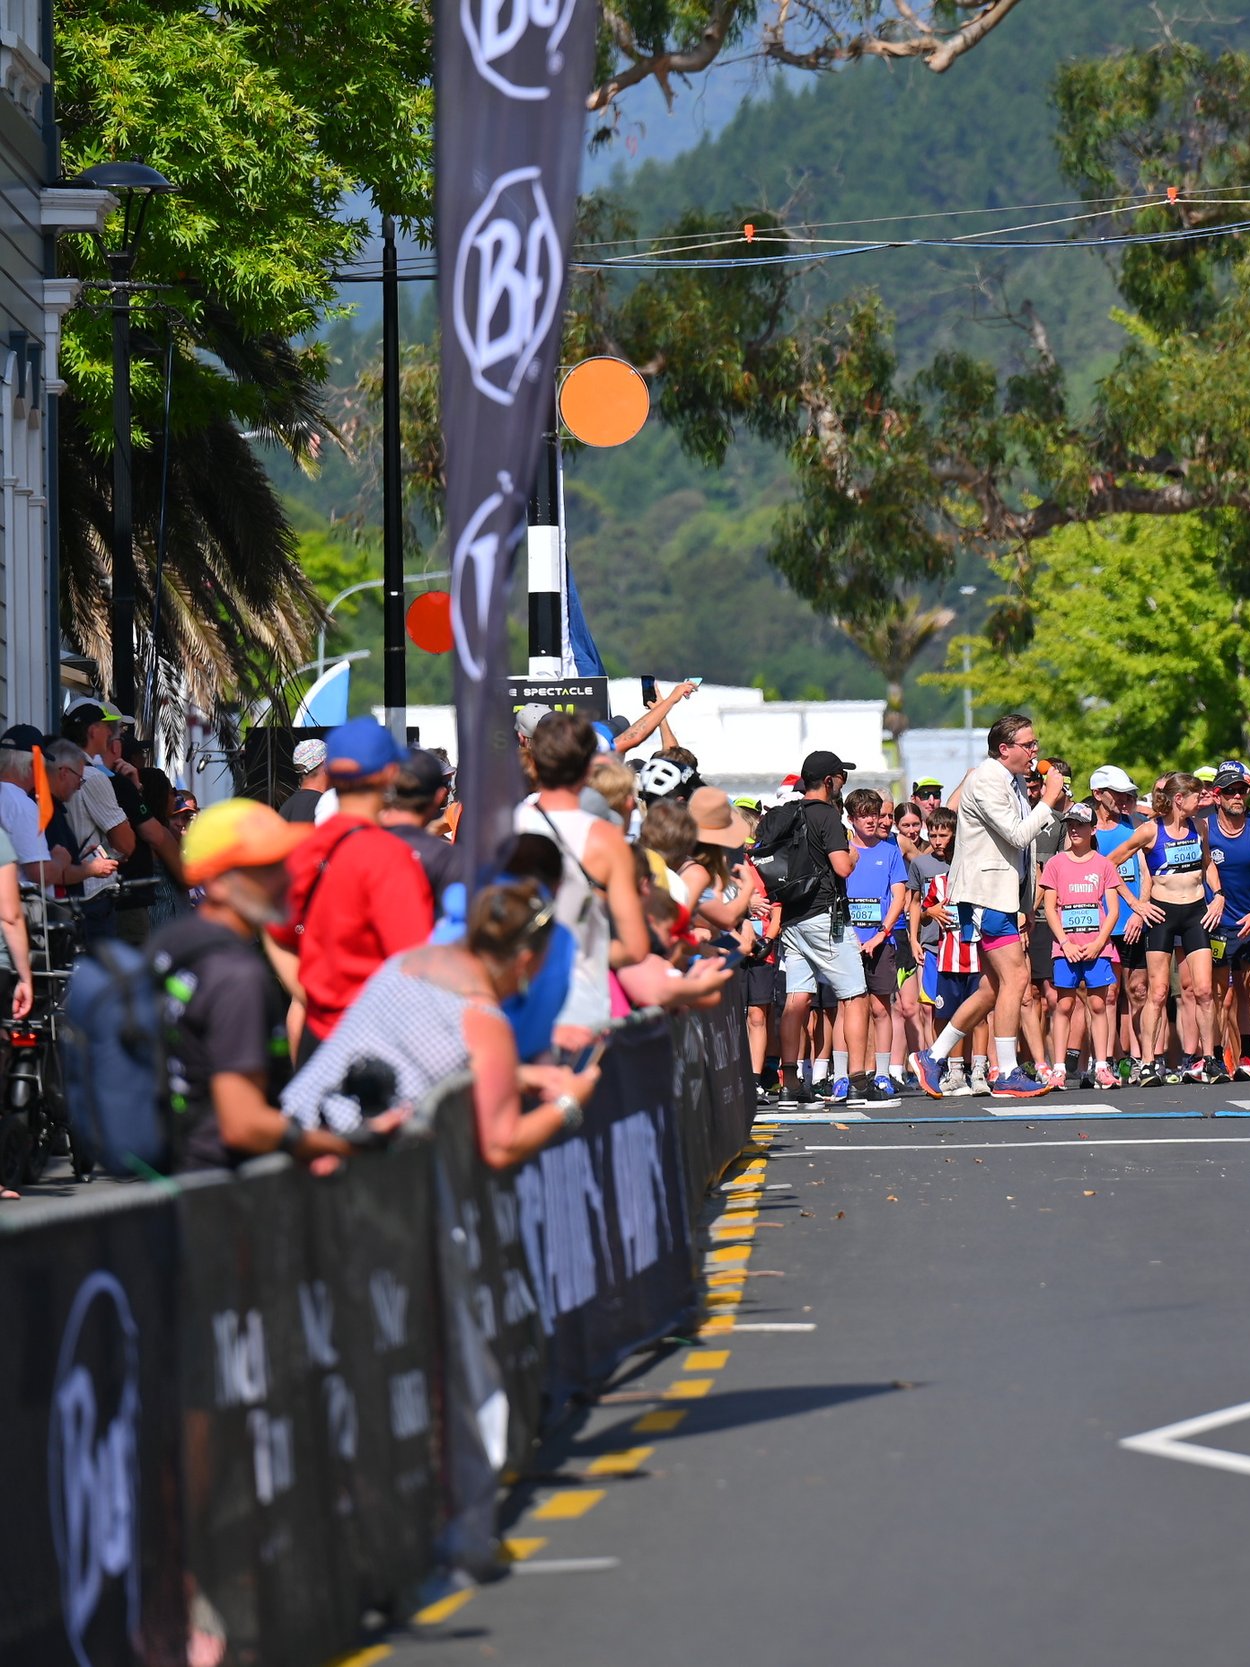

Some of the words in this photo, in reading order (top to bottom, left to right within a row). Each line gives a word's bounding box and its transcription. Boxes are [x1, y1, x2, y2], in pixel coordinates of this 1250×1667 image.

[524, 687, 593, 696] SPECTACLE
[1174, 851, 1197, 863] 5040
[851, 911, 873, 920] 5087
[1068, 915, 1093, 926] 5079
